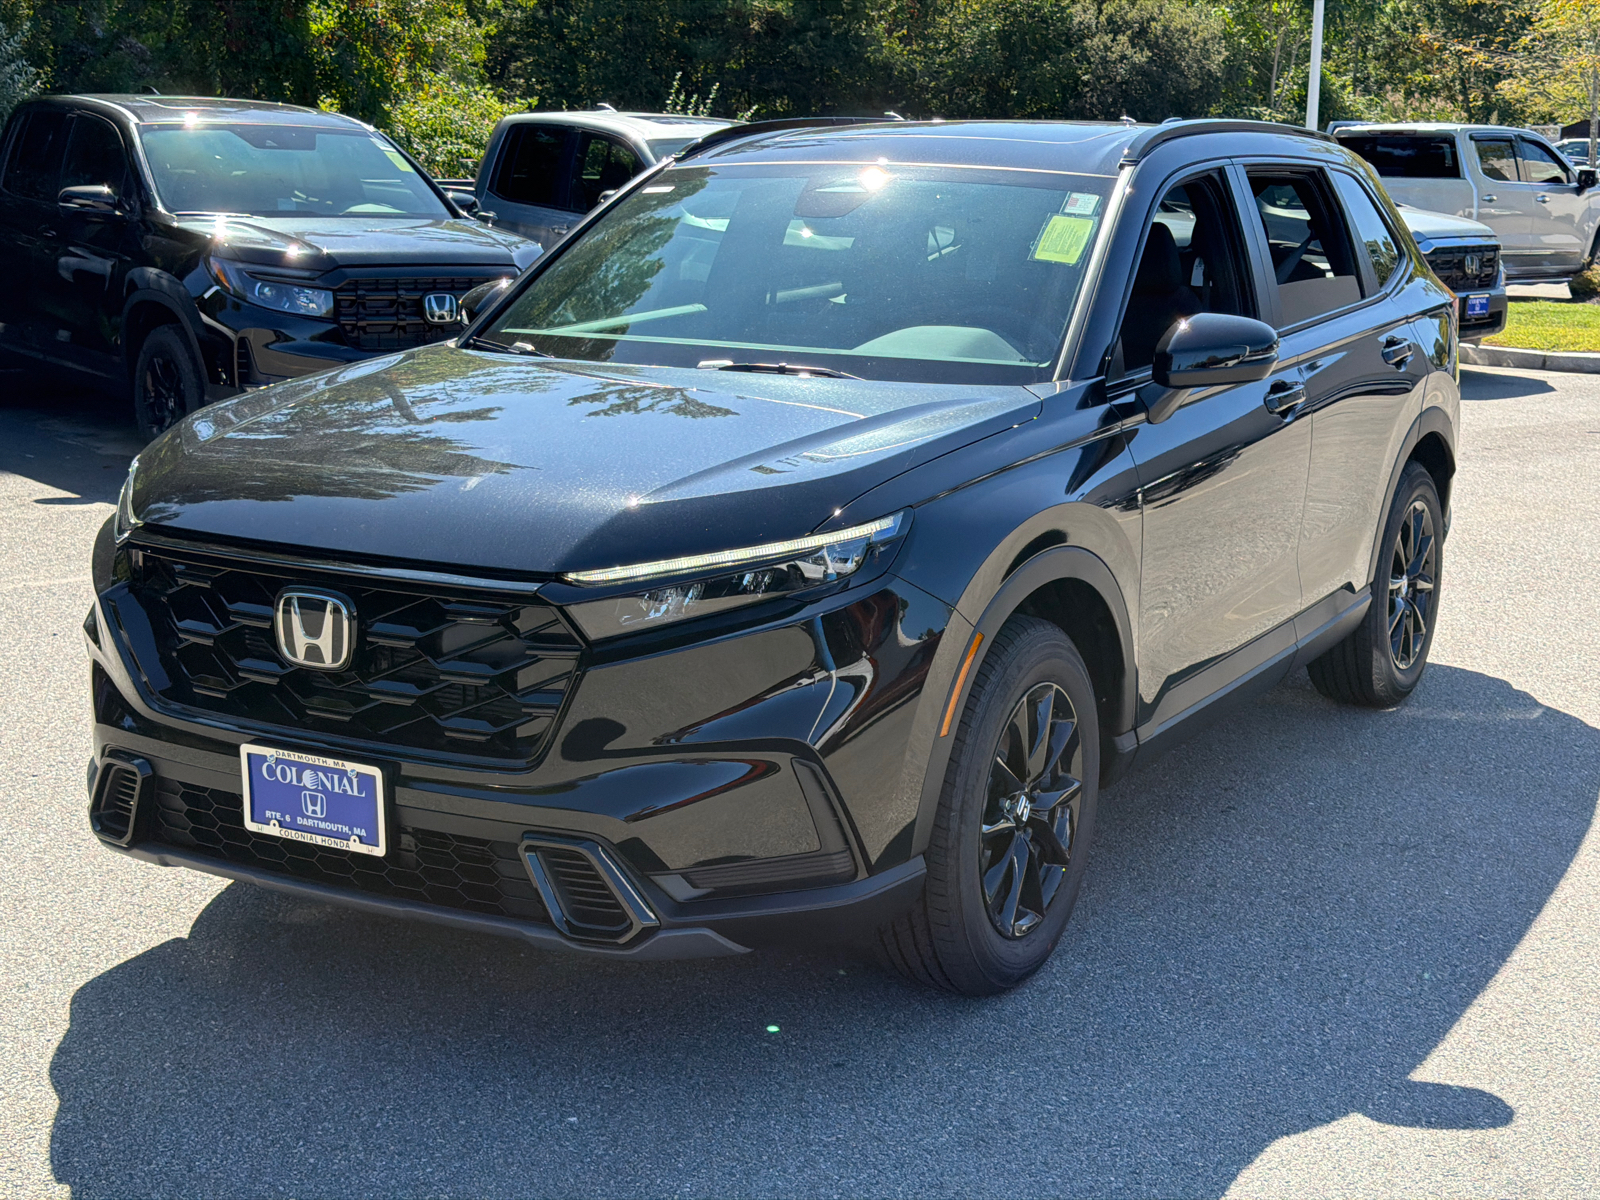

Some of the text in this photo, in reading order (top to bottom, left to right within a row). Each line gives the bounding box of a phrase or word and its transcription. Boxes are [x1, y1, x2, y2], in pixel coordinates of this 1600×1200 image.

[333, 761, 347, 769] MA
[262, 761, 366, 797] COLONIAL
[265, 810, 367, 837] RTE. 6 DARTMOUTH, MA
[279, 829, 351, 850] COLONIAL HONDA
